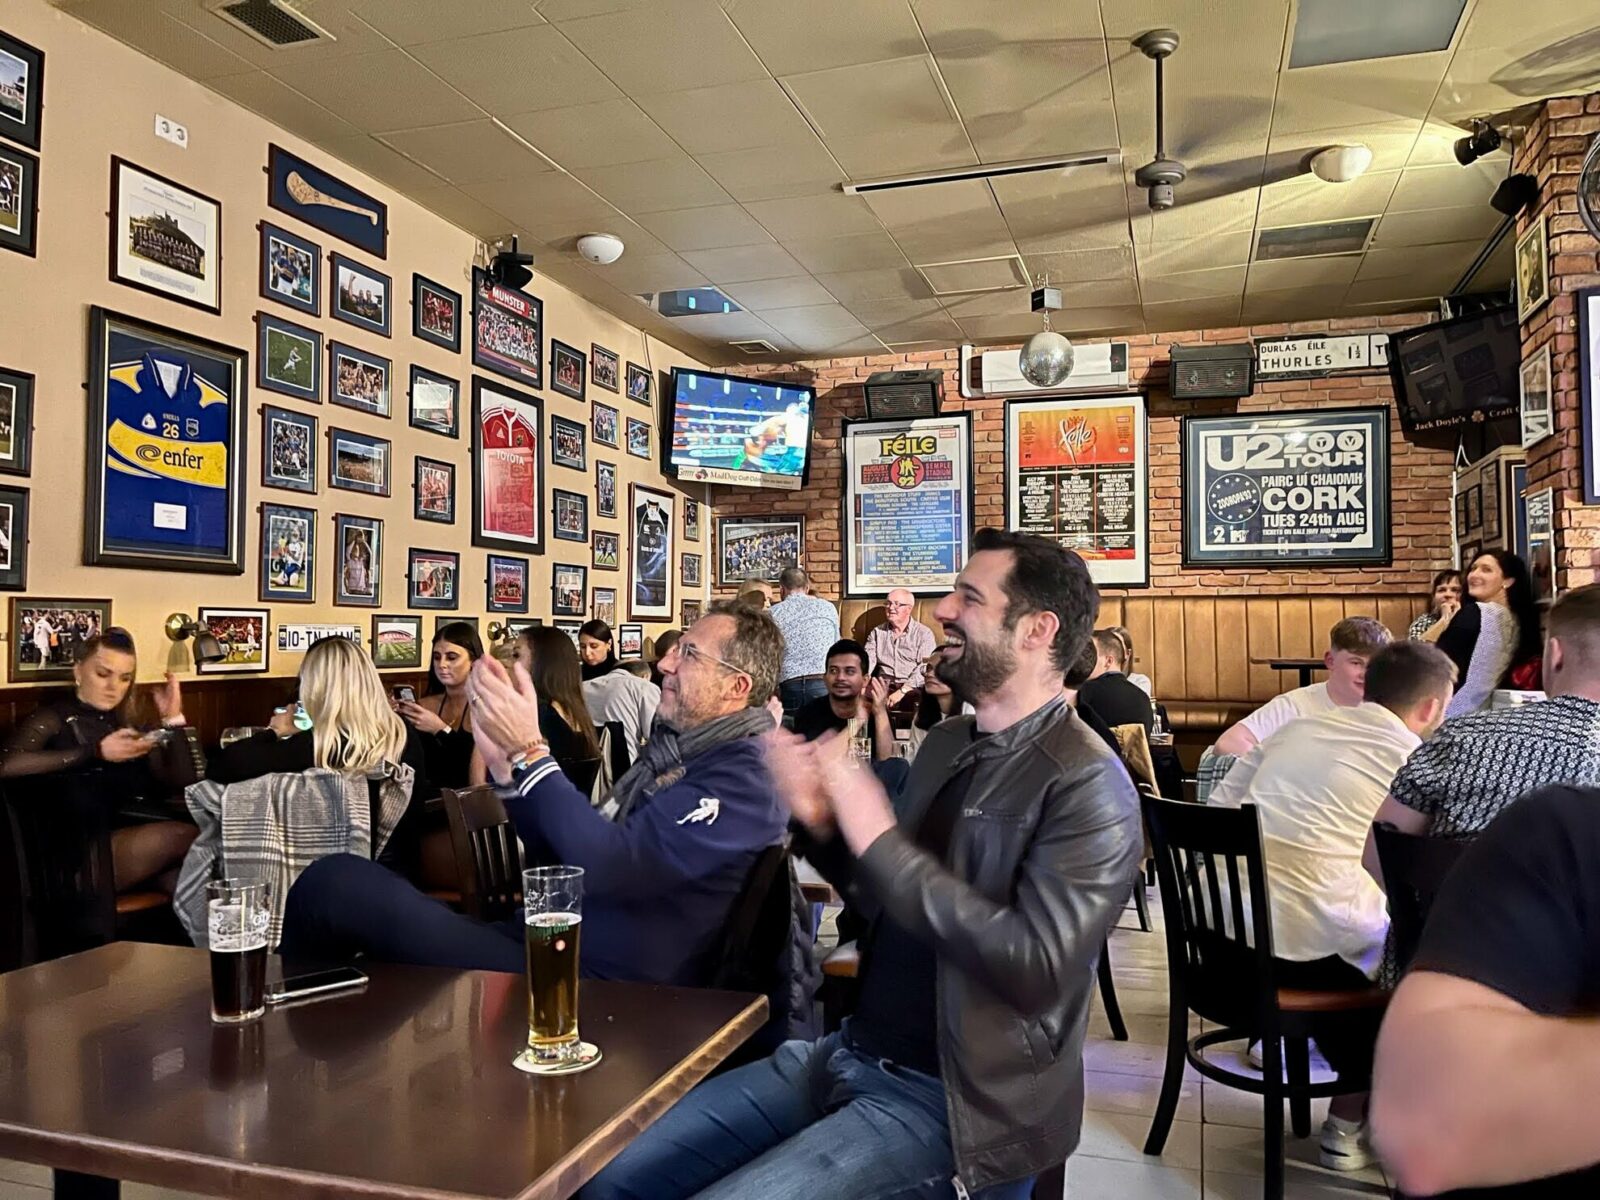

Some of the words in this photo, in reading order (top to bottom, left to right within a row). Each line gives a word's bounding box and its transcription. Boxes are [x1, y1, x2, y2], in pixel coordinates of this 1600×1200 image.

[492, 287, 525, 312] MUNSTER
[1261, 344, 1297, 354] DURLAS
[1307, 340, 1326, 350] ÉILE
[1261, 354, 1332, 369] THURLES
[1414, 422, 1434, 431] Jack
[1436, 416, 1466, 427] Doyle's
[1489, 406, 1513, 418] Craft
[162, 422, 180, 438] 26
[880, 434, 936, 456] FÉILE
[1206, 435, 1284, 471] U2
[163, 447, 204, 470] enfer
[496, 451, 525, 466] TOYOTA
[1284, 452, 1364, 468] TOUR
[710, 471, 738, 482] MadDog
[926, 468, 952, 476] STADIUM
[1262, 475, 1294, 488] PAIRC
[1310, 472, 1362, 486] CHAIOMH
[898, 476, 916, 486] 92
[1262, 486, 1364, 512] CORK
[1262, 514, 1296, 528] TUES
[1300, 514, 1332, 527] 24th
[1336, 512, 1364, 526] AUG
[1214, 526, 1226, 544] 2
